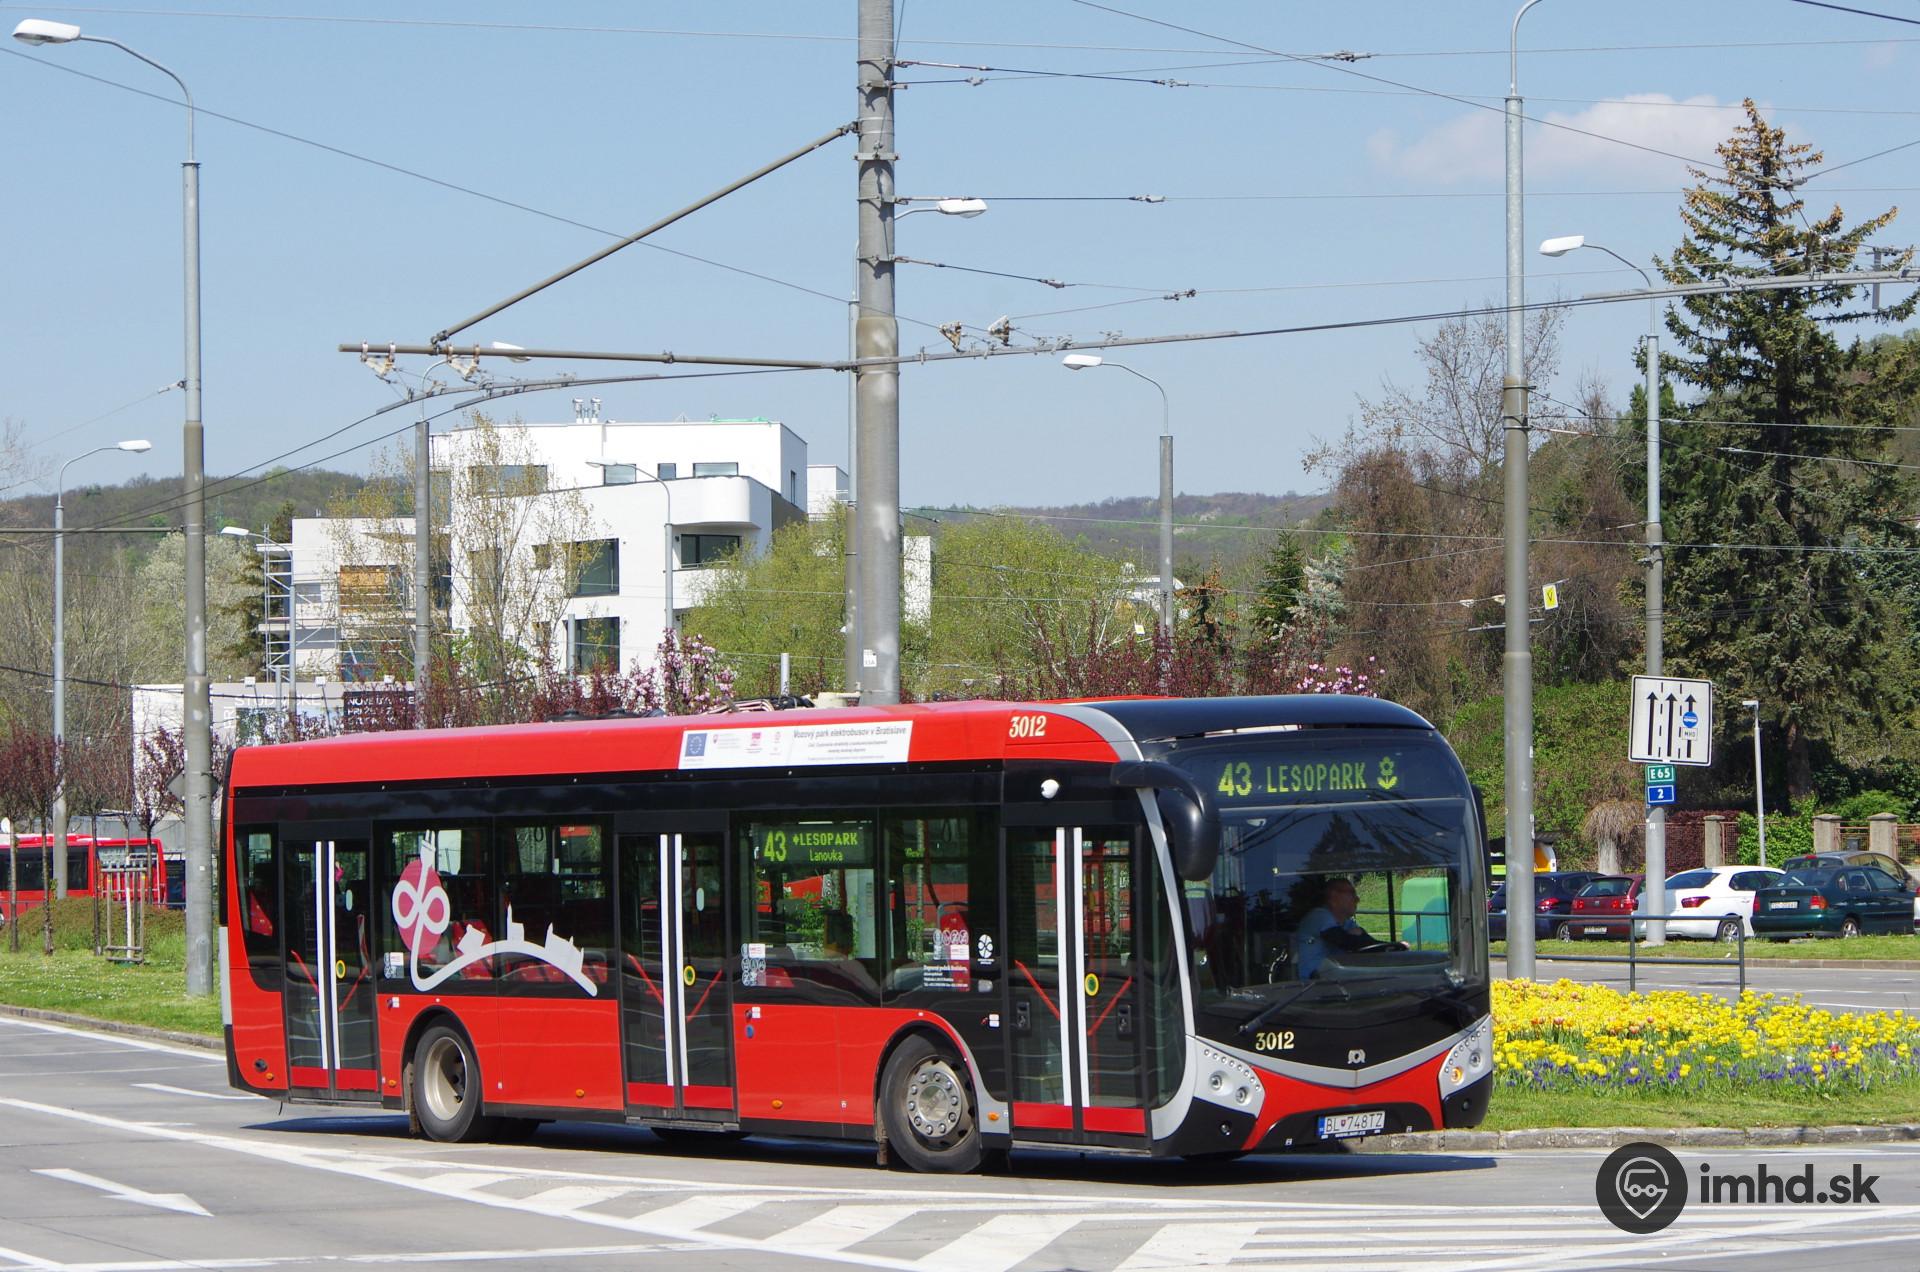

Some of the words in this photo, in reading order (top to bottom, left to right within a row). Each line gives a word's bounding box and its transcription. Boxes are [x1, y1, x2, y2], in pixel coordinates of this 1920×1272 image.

[1009, 715, 1047, 738] 3012
[1218, 762, 1252, 796] 43
[1266, 762, 1367, 793] LESOPARK
[1657, 788, 1664, 799] 2
[764, 831, 787, 861] 43
[799, 832, 858, 846] LESOPARK
[809, 849, 843, 861] Lanovka
[1255, 1031, 1295, 1051] 3012
[1326, 1118, 1340, 1133] BL
[1347, 1113, 1382, 1130] 748TZ
